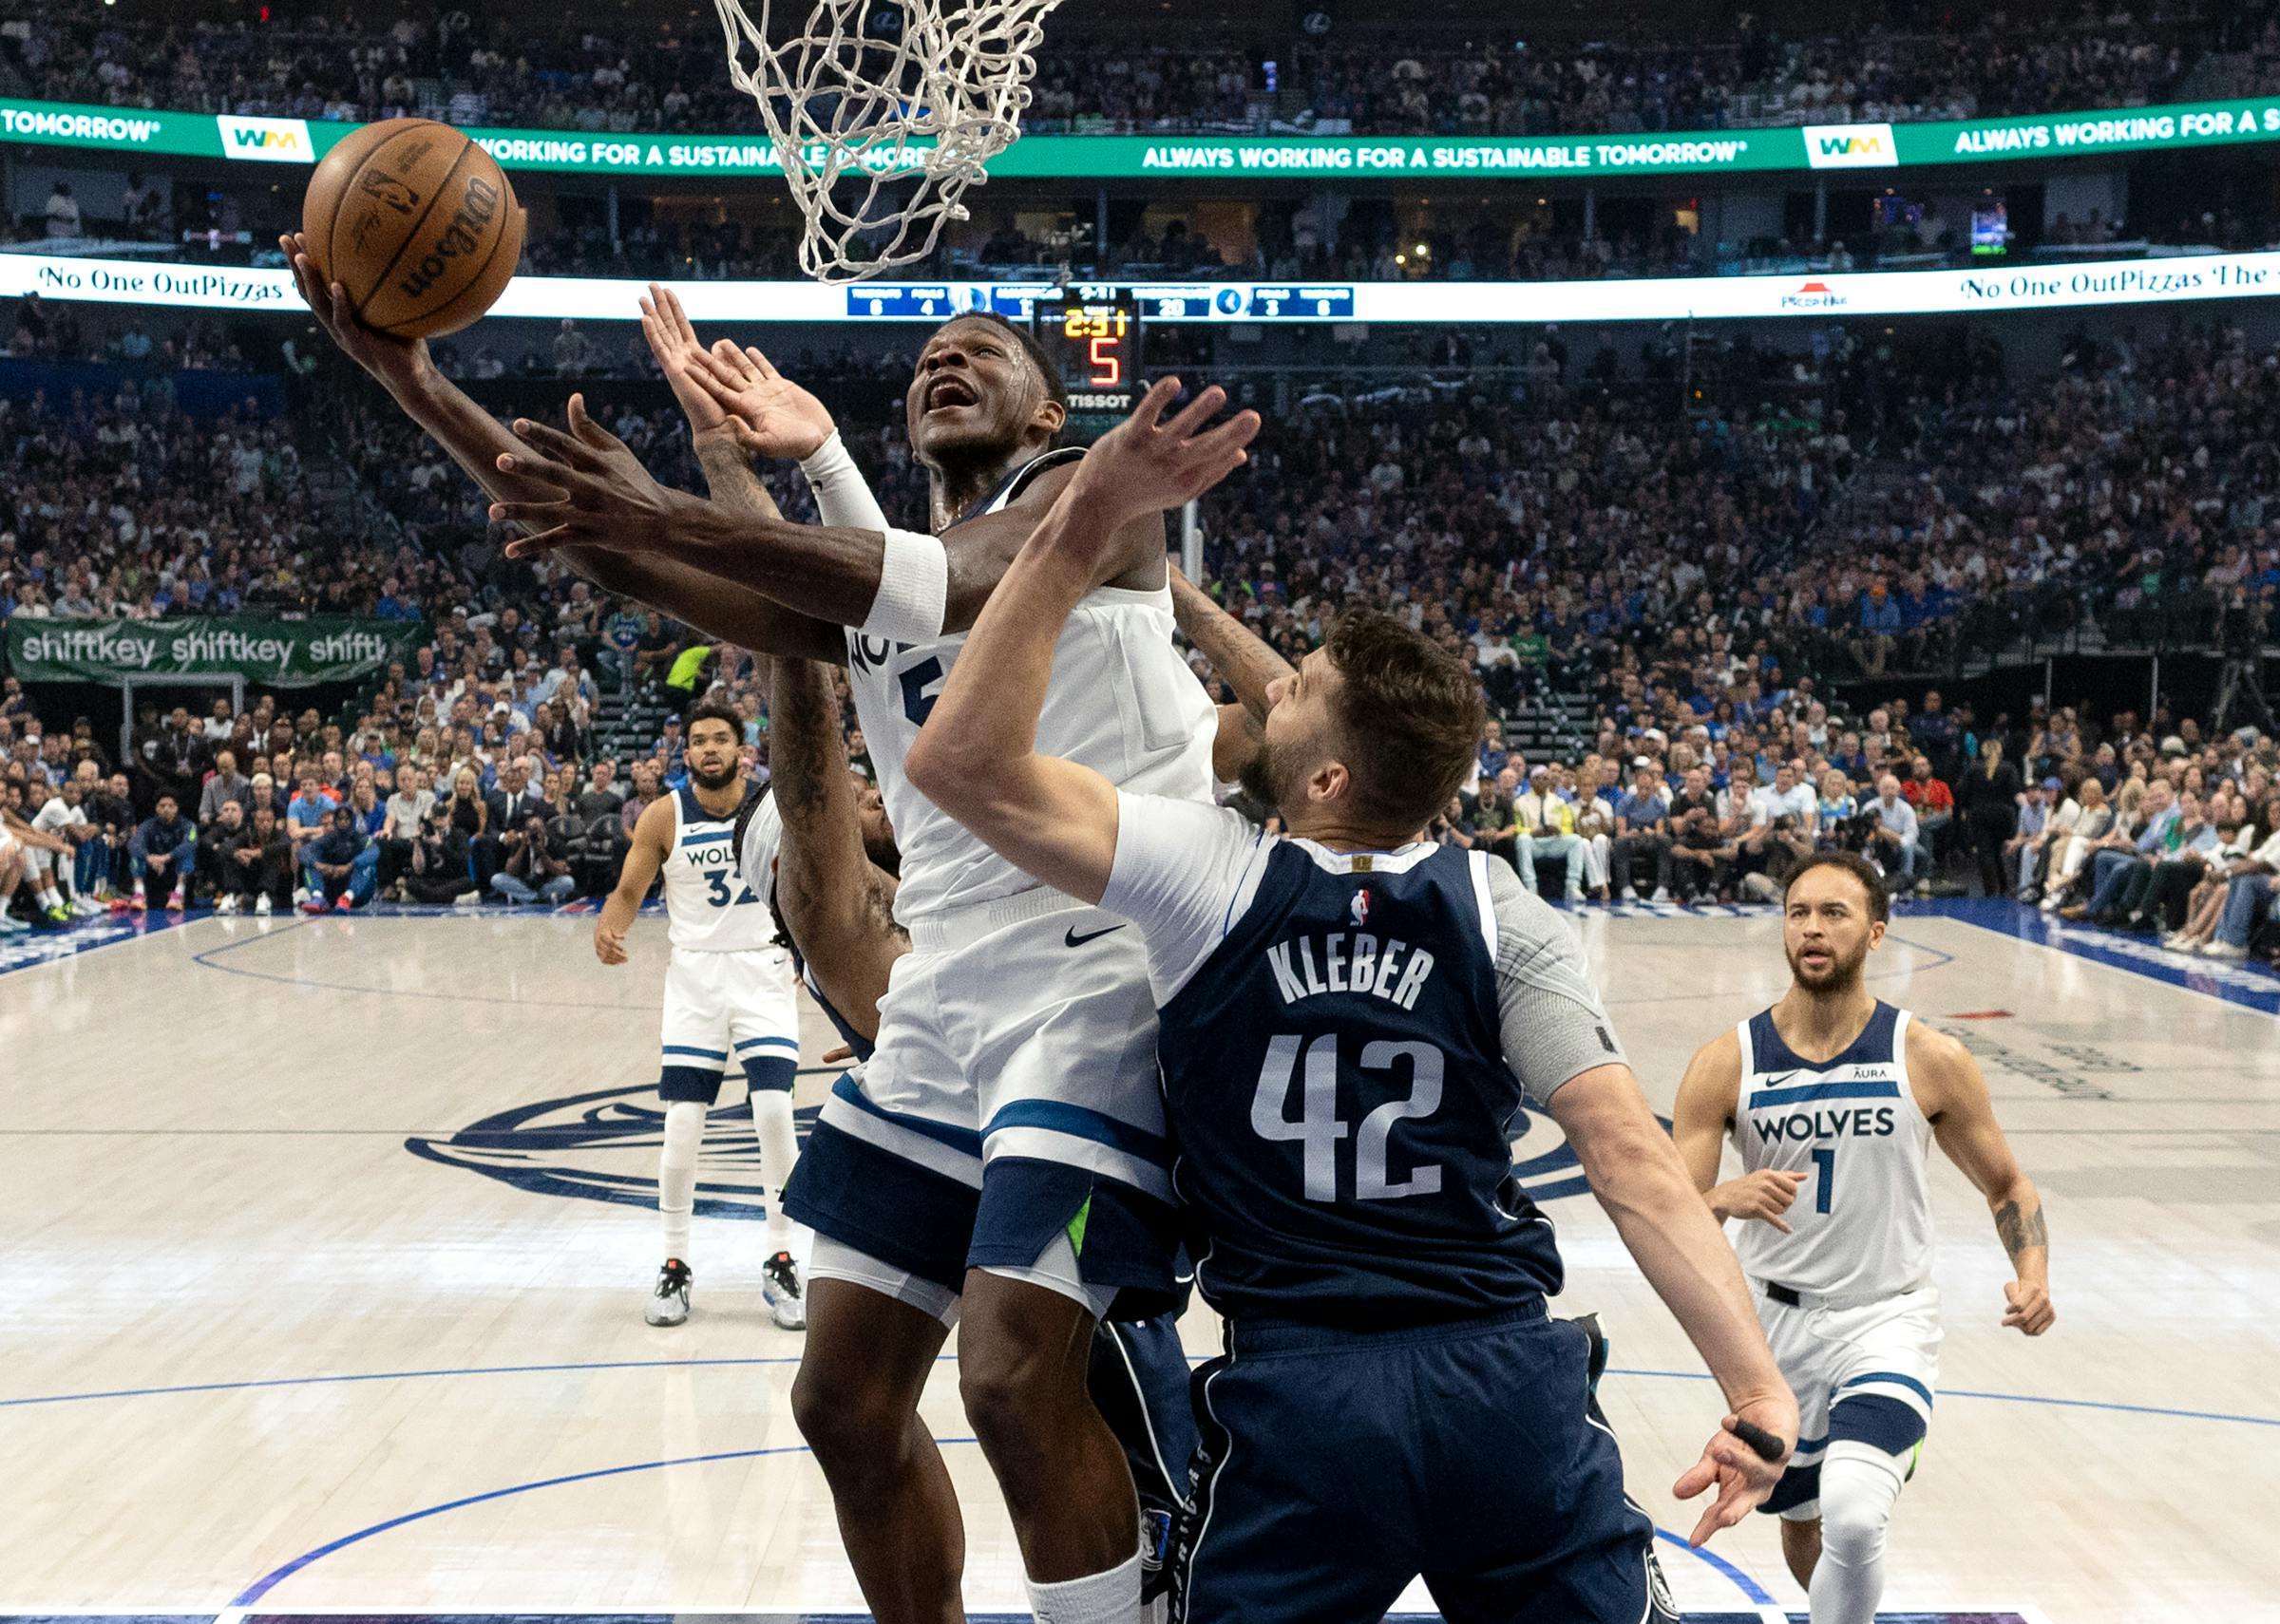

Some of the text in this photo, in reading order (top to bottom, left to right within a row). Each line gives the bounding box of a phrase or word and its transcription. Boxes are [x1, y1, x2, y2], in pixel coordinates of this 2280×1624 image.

[234, 128, 297, 148] WM
[1819, 137, 1880, 155] WM
[1954, 125, 2049, 153] ALWAYS
[2054, 116, 2175, 146] WORKING
[2180, 111, 2233, 138] FOR
[2236, 109, 2257, 133] A
[592, 142, 640, 165] FOR
[645, 144, 664, 166] A
[1142, 147, 1234, 168] ALWAYS
[1239, 147, 1352, 168] WORKING
[1357, 147, 1405, 168] FOR
[1410, 147, 1428, 168] A
[1433, 146, 1590, 168] SUSTAINABLE
[401, 175, 498, 298] Wilson
[91, 269, 143, 292] One
[154, 273, 283, 302] OutPizzas
[2010, 274, 2062, 297] One
[2071, 269, 2202, 293] OutPizzas
[1065, 309, 1126, 337] 2:31
[1090, 337, 1118, 385] 5
[1066, 394, 1131, 408] TISSOT
[22, 631, 155, 668] shiftkey
[172, 631, 294, 668] shiftkey
[1267, 933, 1434, 1010] KLEBER
[1250, 1033, 1445, 1202] 42
[1753, 1107, 1894, 1144] WOLVES
[1812, 1148, 1835, 1214] 1
